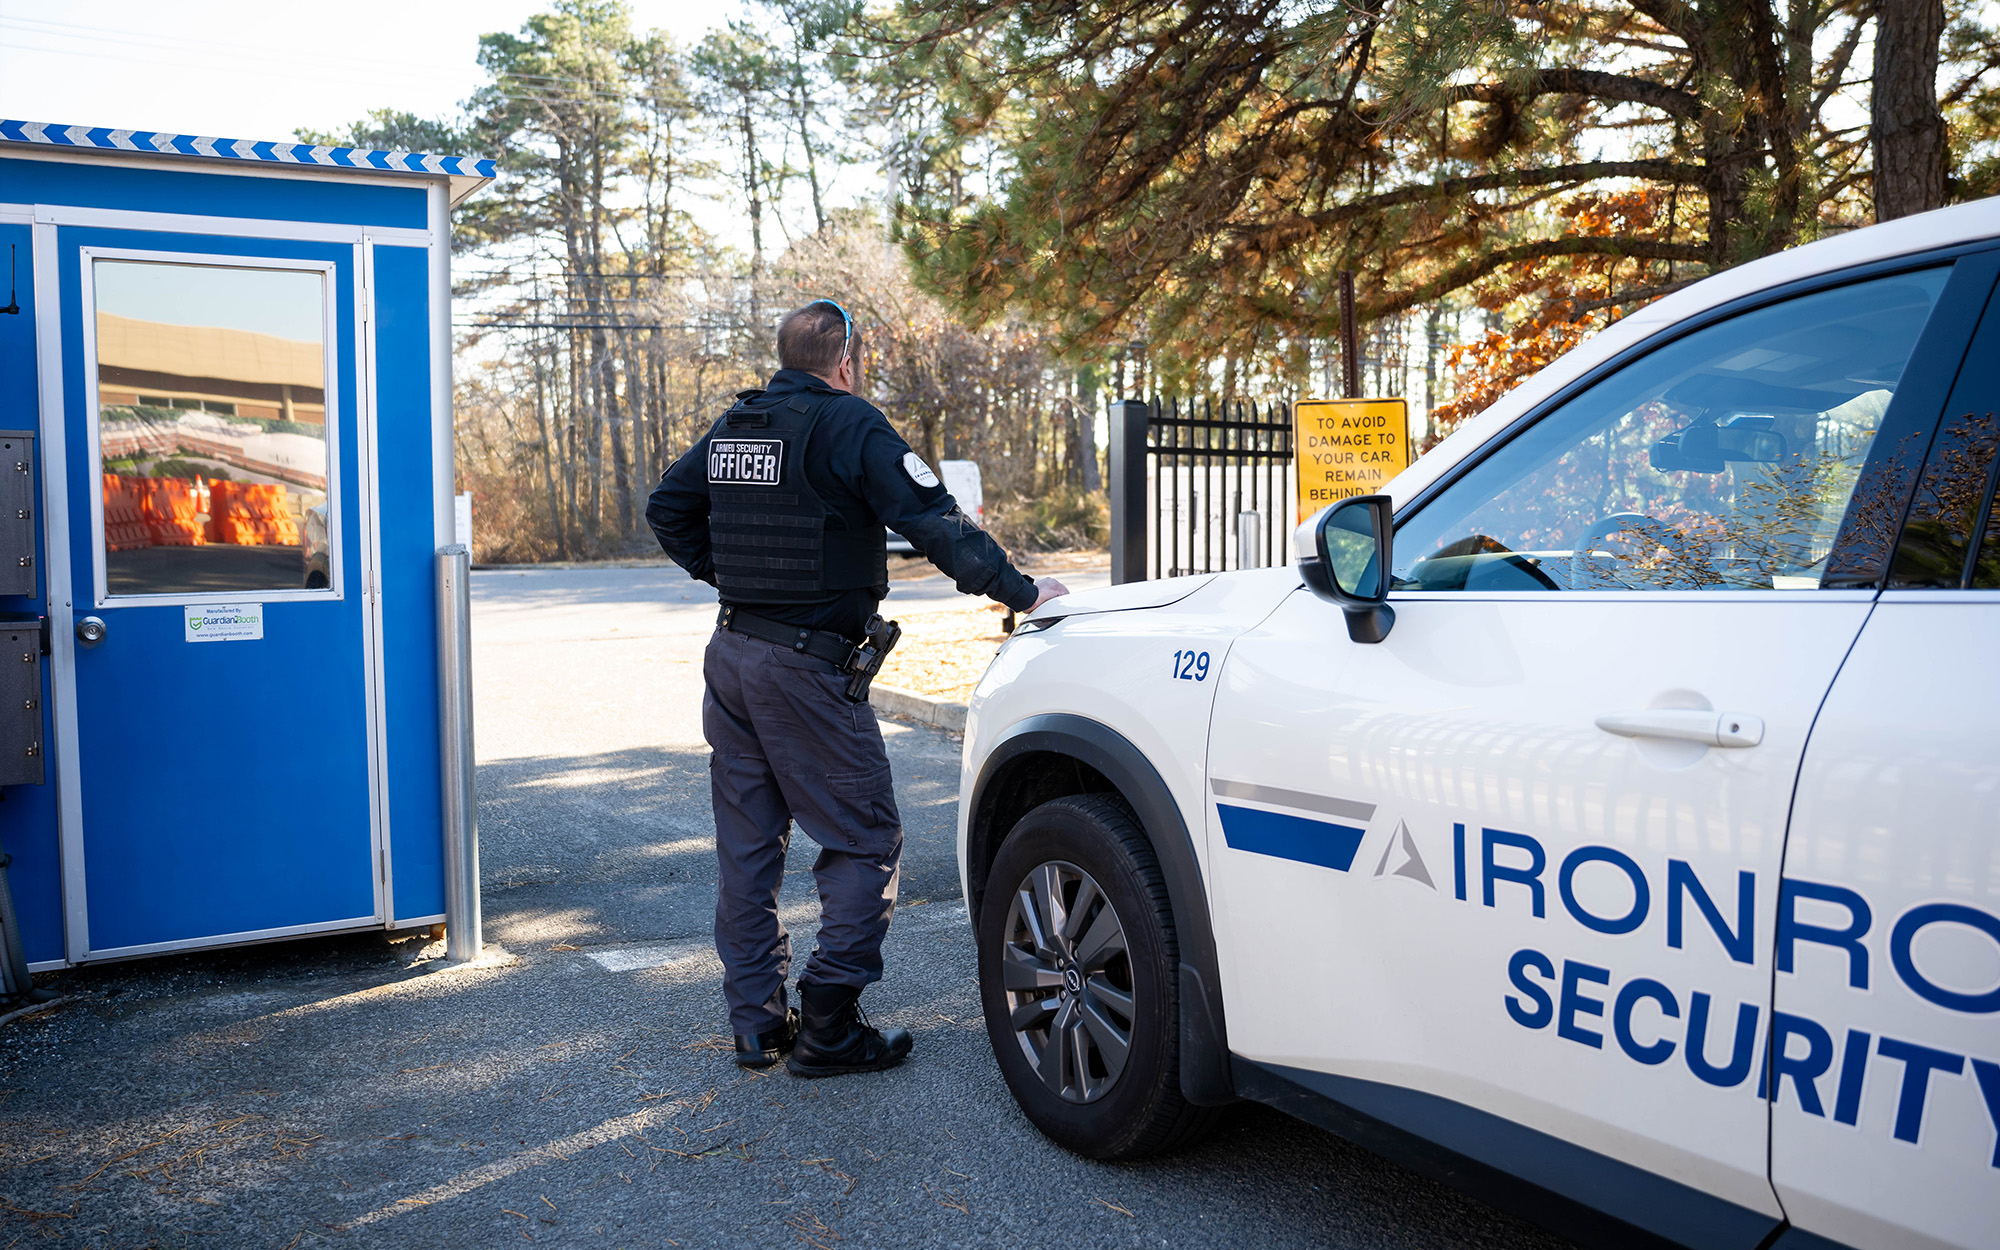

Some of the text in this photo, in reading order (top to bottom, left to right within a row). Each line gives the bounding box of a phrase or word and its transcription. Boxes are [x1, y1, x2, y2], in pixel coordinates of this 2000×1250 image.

[1316, 416, 1386, 430] TO AVOID
[1309, 433, 1396, 447] DAMAGE TO
[715, 443, 772, 454] ARMED SECURITY
[1312, 451, 1394, 465] YOUR CAR.
[711, 453, 776, 481] OFFICER
[1325, 469, 1382, 482] REMAIN
[1310, 487, 1364, 500] BEHIND
[1173, 649, 1210, 682] 129
[1453, 822, 2000, 1014] IRONRO
